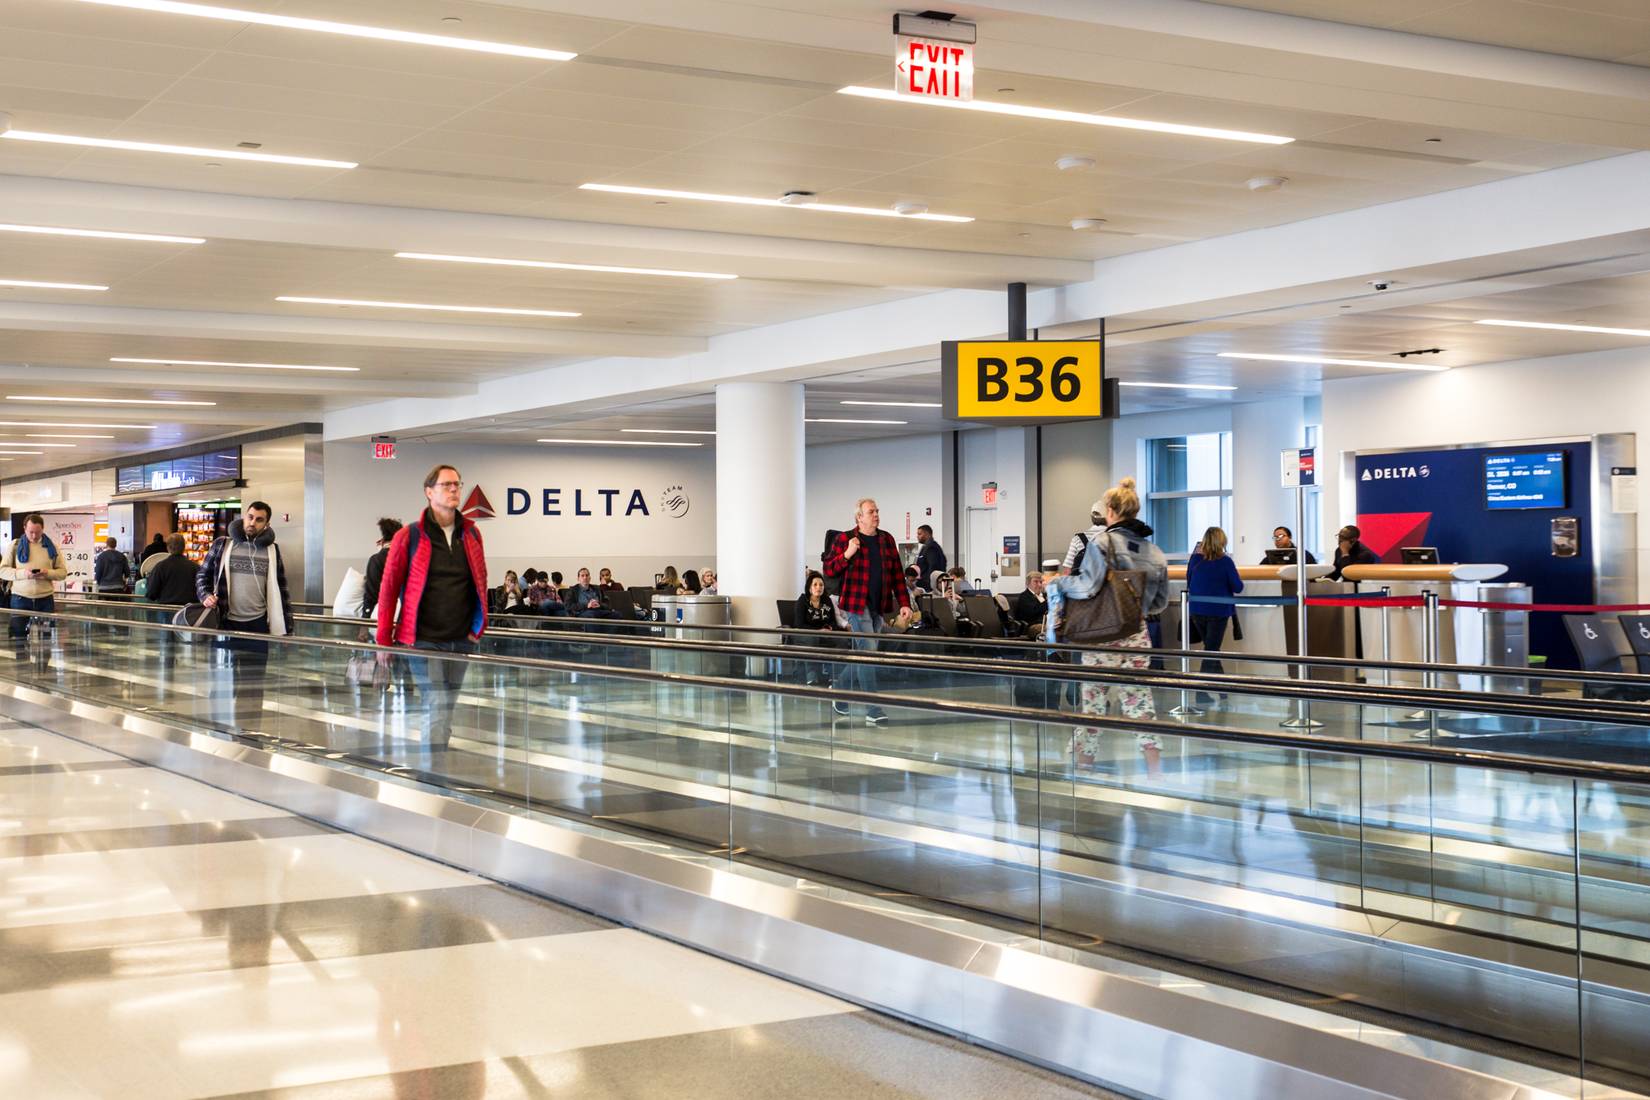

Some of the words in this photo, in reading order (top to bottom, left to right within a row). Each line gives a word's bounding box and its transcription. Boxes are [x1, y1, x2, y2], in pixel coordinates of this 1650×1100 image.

[910, 42, 964, 97] EXIT
[977, 356, 1081, 402] B36
[376, 444, 392, 458] EXIT
[1374, 466, 1416, 480] DELTA
[507, 488, 650, 516] DELTA
